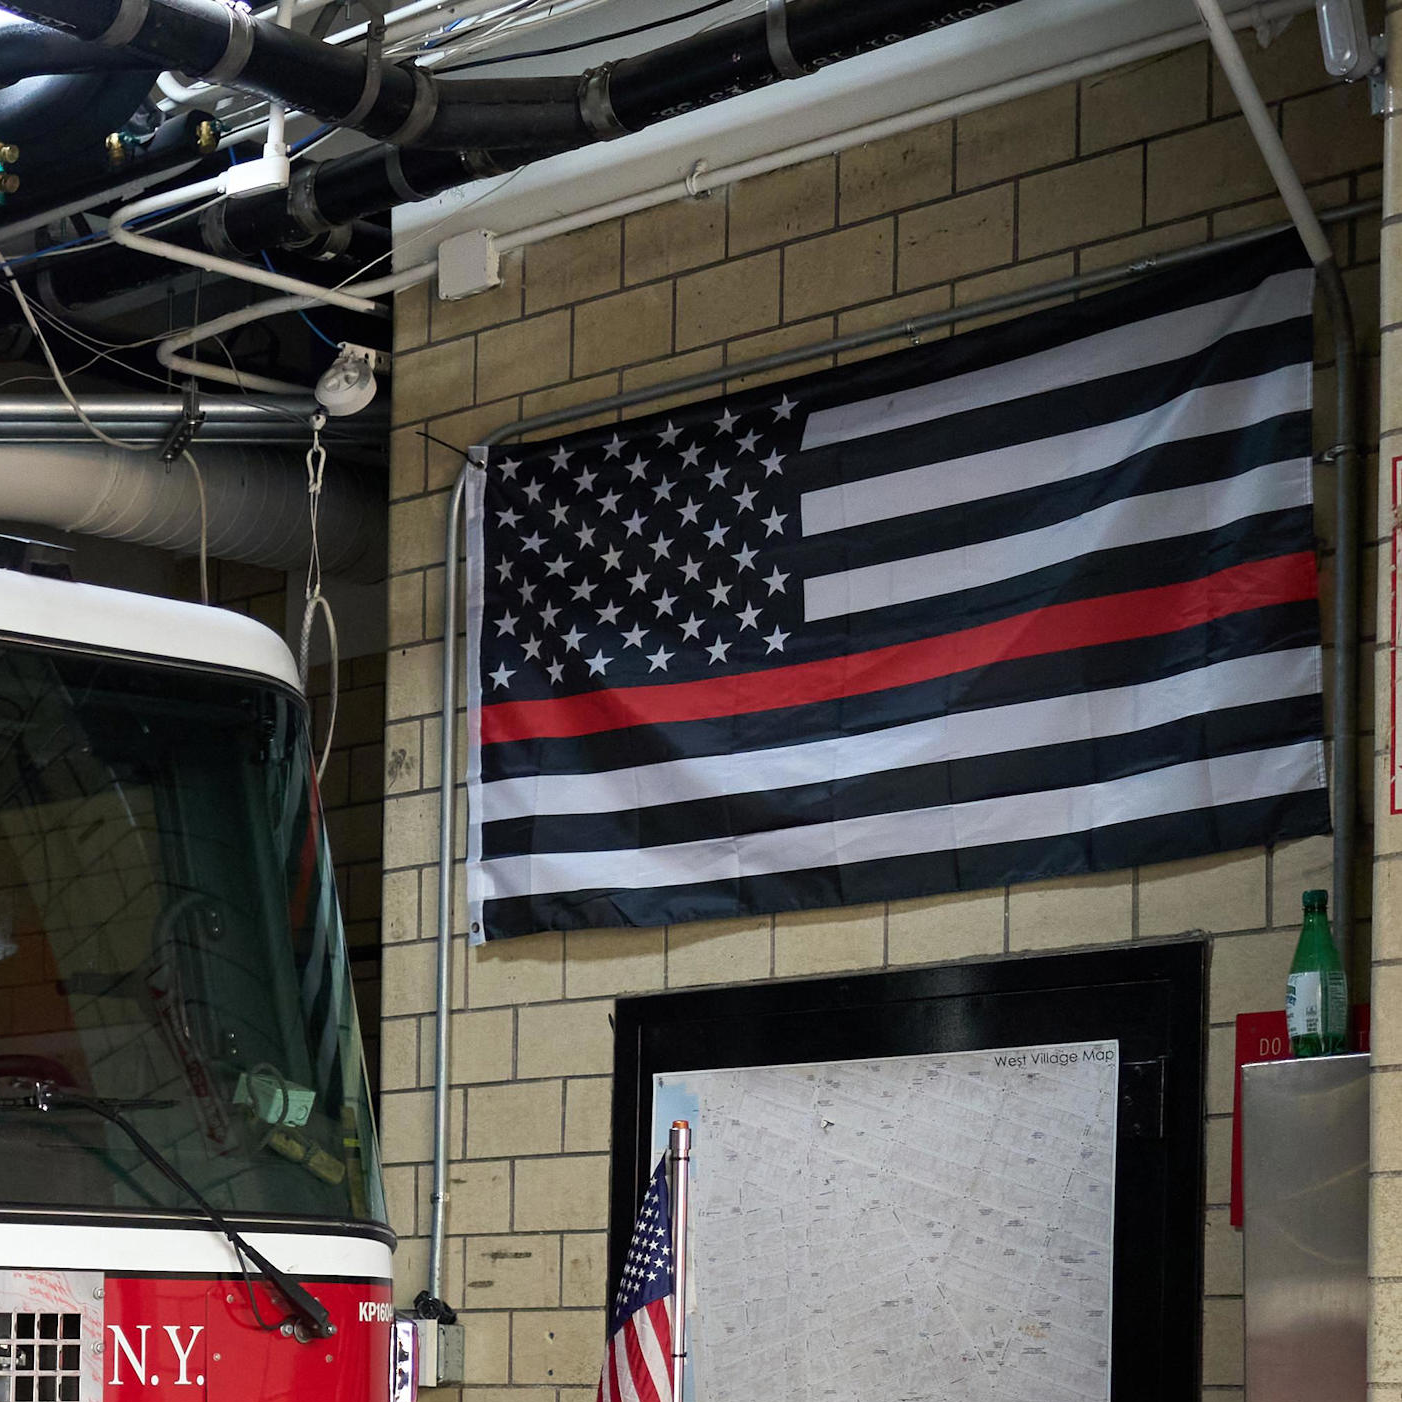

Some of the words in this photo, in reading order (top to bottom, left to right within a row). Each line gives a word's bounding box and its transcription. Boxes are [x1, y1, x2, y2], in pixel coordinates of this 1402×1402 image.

[1259, 1036, 1282, 1056] DO
[994, 1054, 1027, 1068] West
[1031, 1051, 1078, 1067] Village
[1082, 1049, 1115, 1063] Map
[107, 1325, 205, 1386] N.Y.
